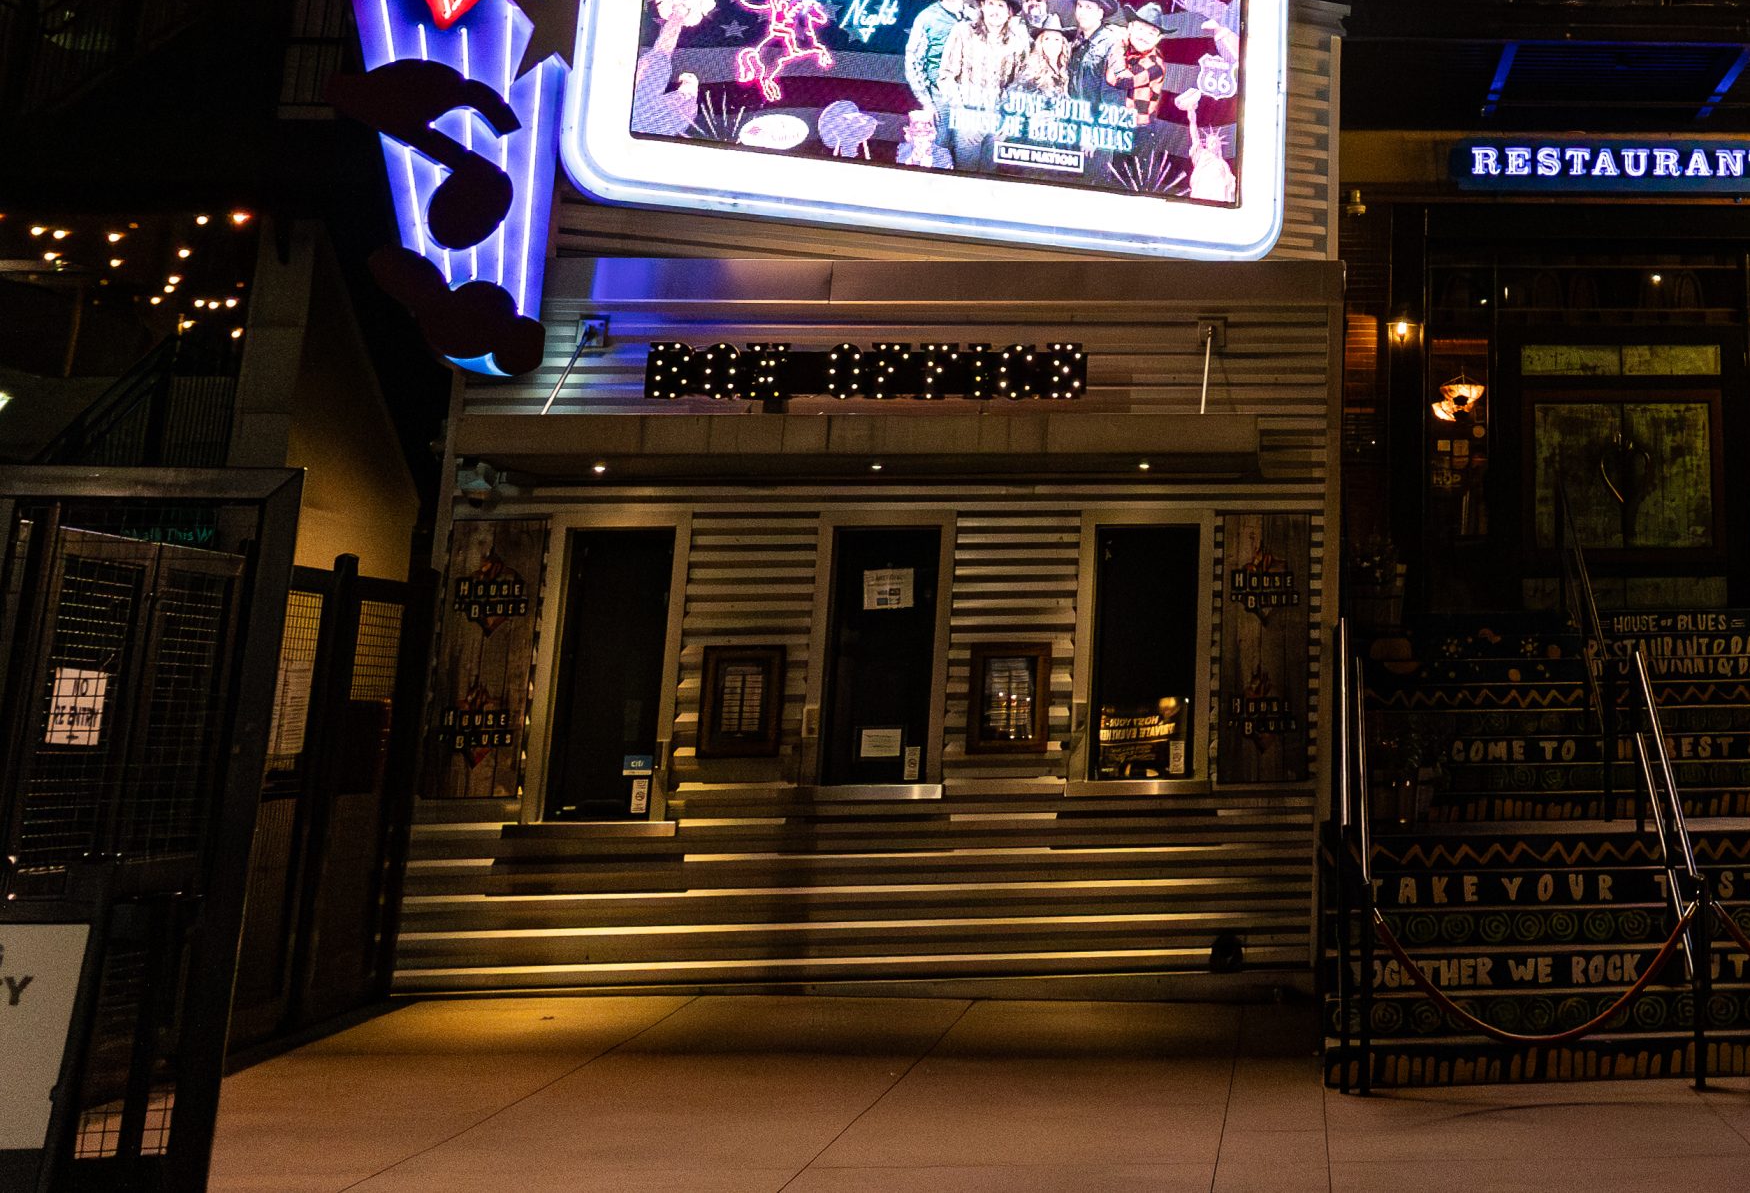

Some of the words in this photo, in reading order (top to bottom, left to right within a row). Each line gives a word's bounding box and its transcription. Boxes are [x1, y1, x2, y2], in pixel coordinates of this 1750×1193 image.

[1204, 70, 1231, 93] 66
[1003, 91, 1050, 117] JUNE
[1098, 104, 1138, 128] 2023
[1003, 114, 1024, 137] OF
[1028, 117, 1077, 144] BLUES
[1080, 125, 1134, 151] DALLAS
[1000, 146, 1030, 162] LIVE
[1031, 150, 1079, 167] NATION
[645, 342, 791, 399] BOX
[827, 342, 1087, 399] OFFICE
[458, 580, 523, 598] HOUSE
[1234, 572, 1293, 589] HOUSE
[470, 602, 528, 618] BLUES
[1613, 614, 1658, 633] HOUSE
[1677, 614, 1727, 632] BLUES
[1584, 636, 1713, 676] RSTAURANT
[1451, 740, 1525, 762] COME
[1540, 739, 1576, 761] TO
[1665, 736, 1734, 759] BEST
[1370, 875, 1478, 904] TAKE
[1501, 874, 1613, 902] YOUR
[1508, 956, 1554, 983] WE
[1571, 953, 1641, 984] ROCK
